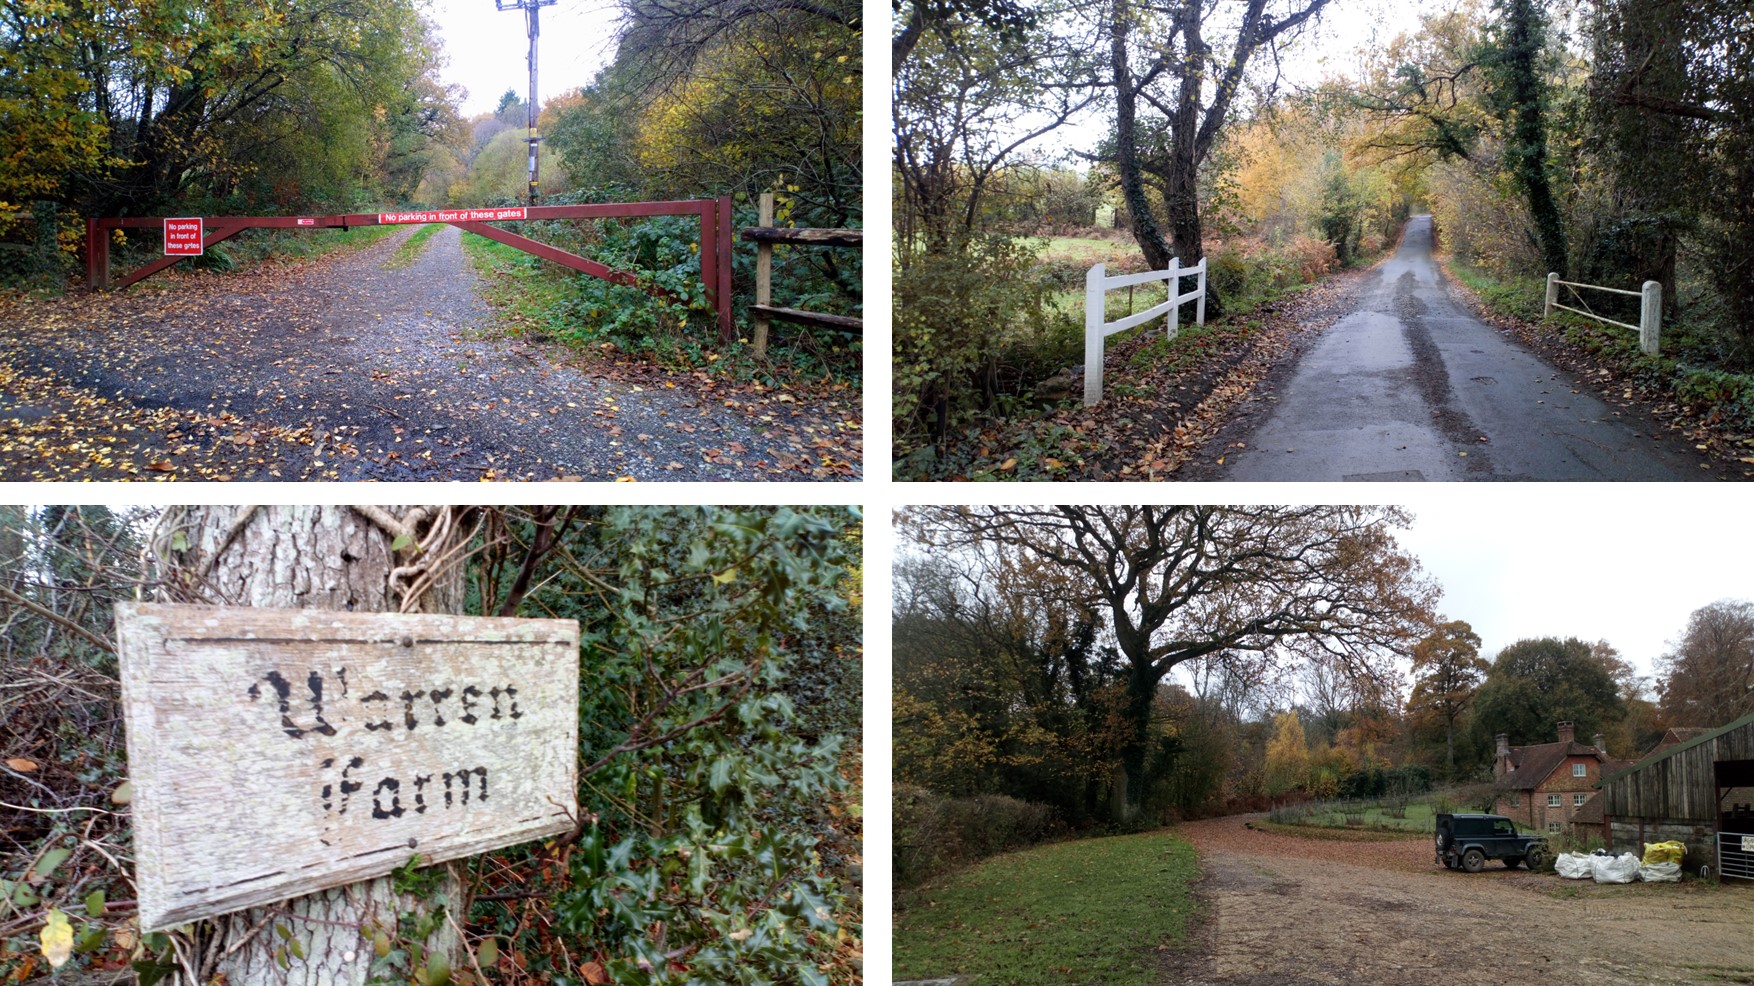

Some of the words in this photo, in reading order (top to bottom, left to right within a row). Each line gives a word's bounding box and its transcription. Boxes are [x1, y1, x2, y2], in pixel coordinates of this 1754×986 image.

[385, 213, 396, 221] No
[398, 212, 427, 222] parking
[429, 212, 436, 220] in
[438, 211, 458, 220] front
[460, 210, 469, 219] of
[470, 209, 494, 218] these
[497, 210, 522, 219] gates
[177, 223, 198, 231] parking
